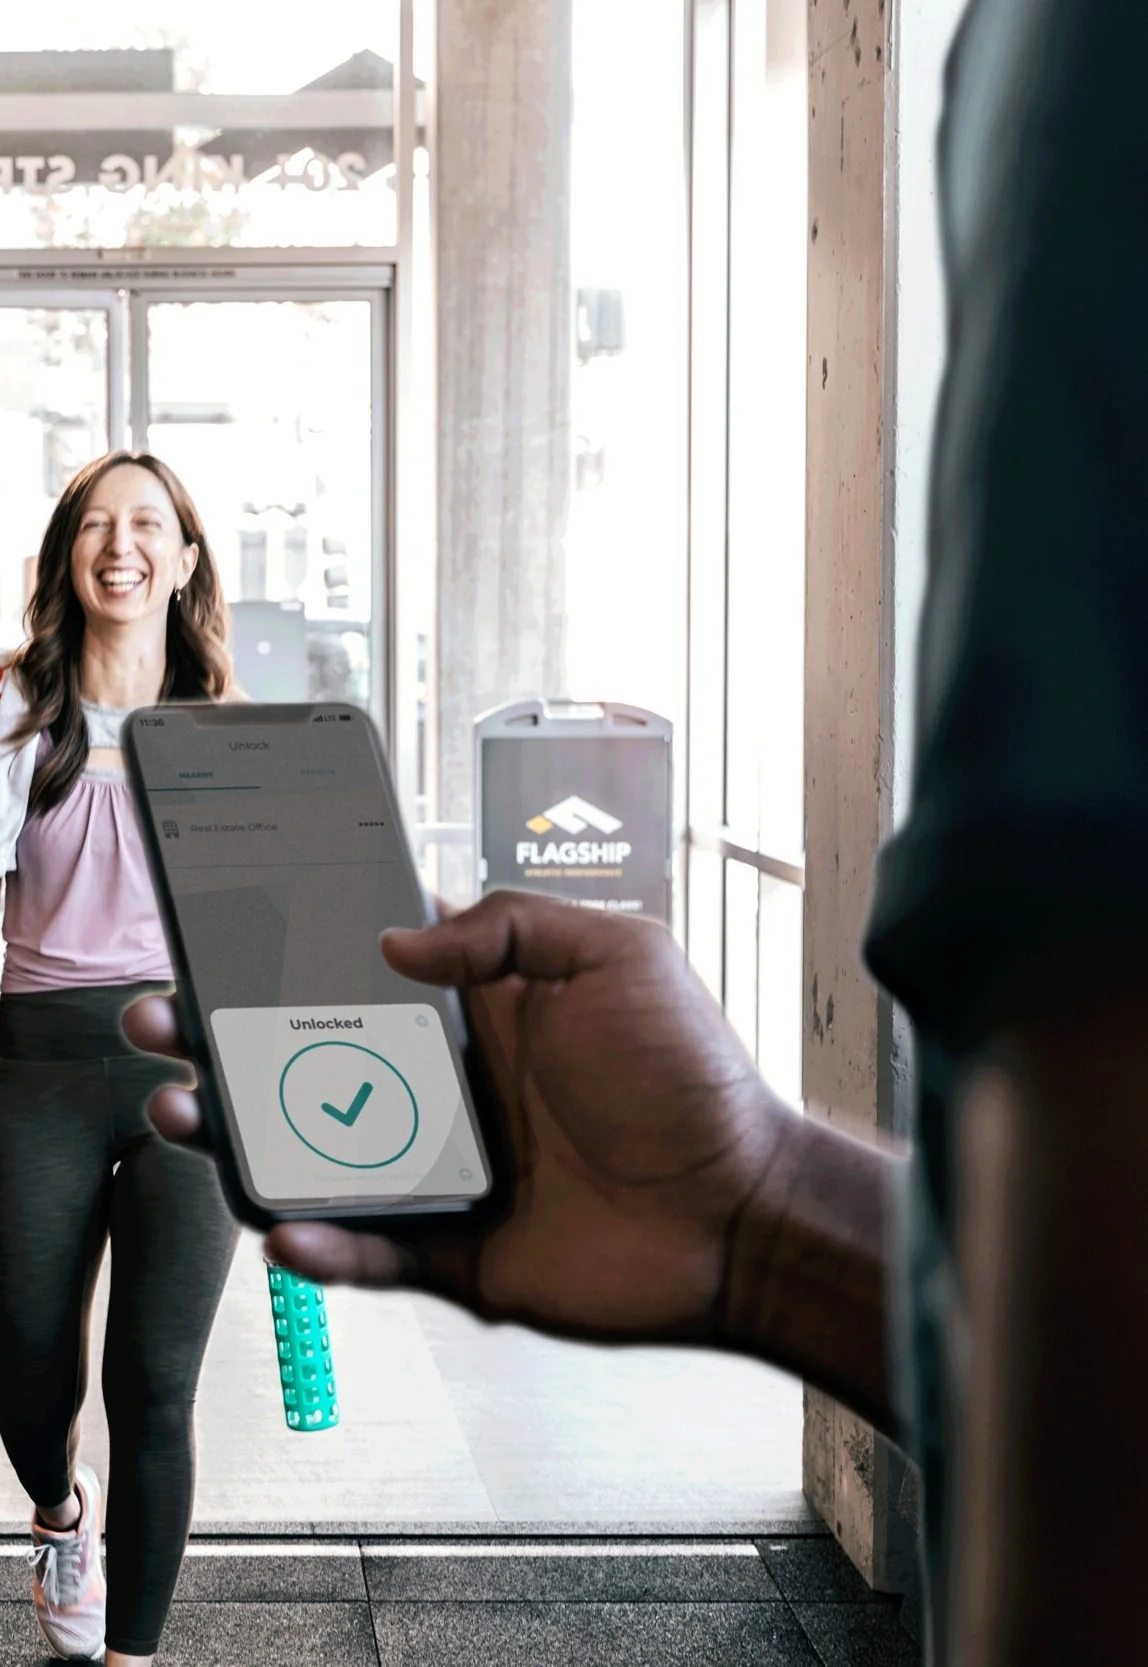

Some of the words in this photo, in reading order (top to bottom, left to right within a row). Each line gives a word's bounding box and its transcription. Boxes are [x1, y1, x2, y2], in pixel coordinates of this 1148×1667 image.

[229, 739, 271, 752] Unlock
[190, 824, 212, 833] Real
[247, 822, 278, 832] Office
[516, 841, 632, 865] FLAGSHIP
[289, 1017, 364, 1031] Unlocked
